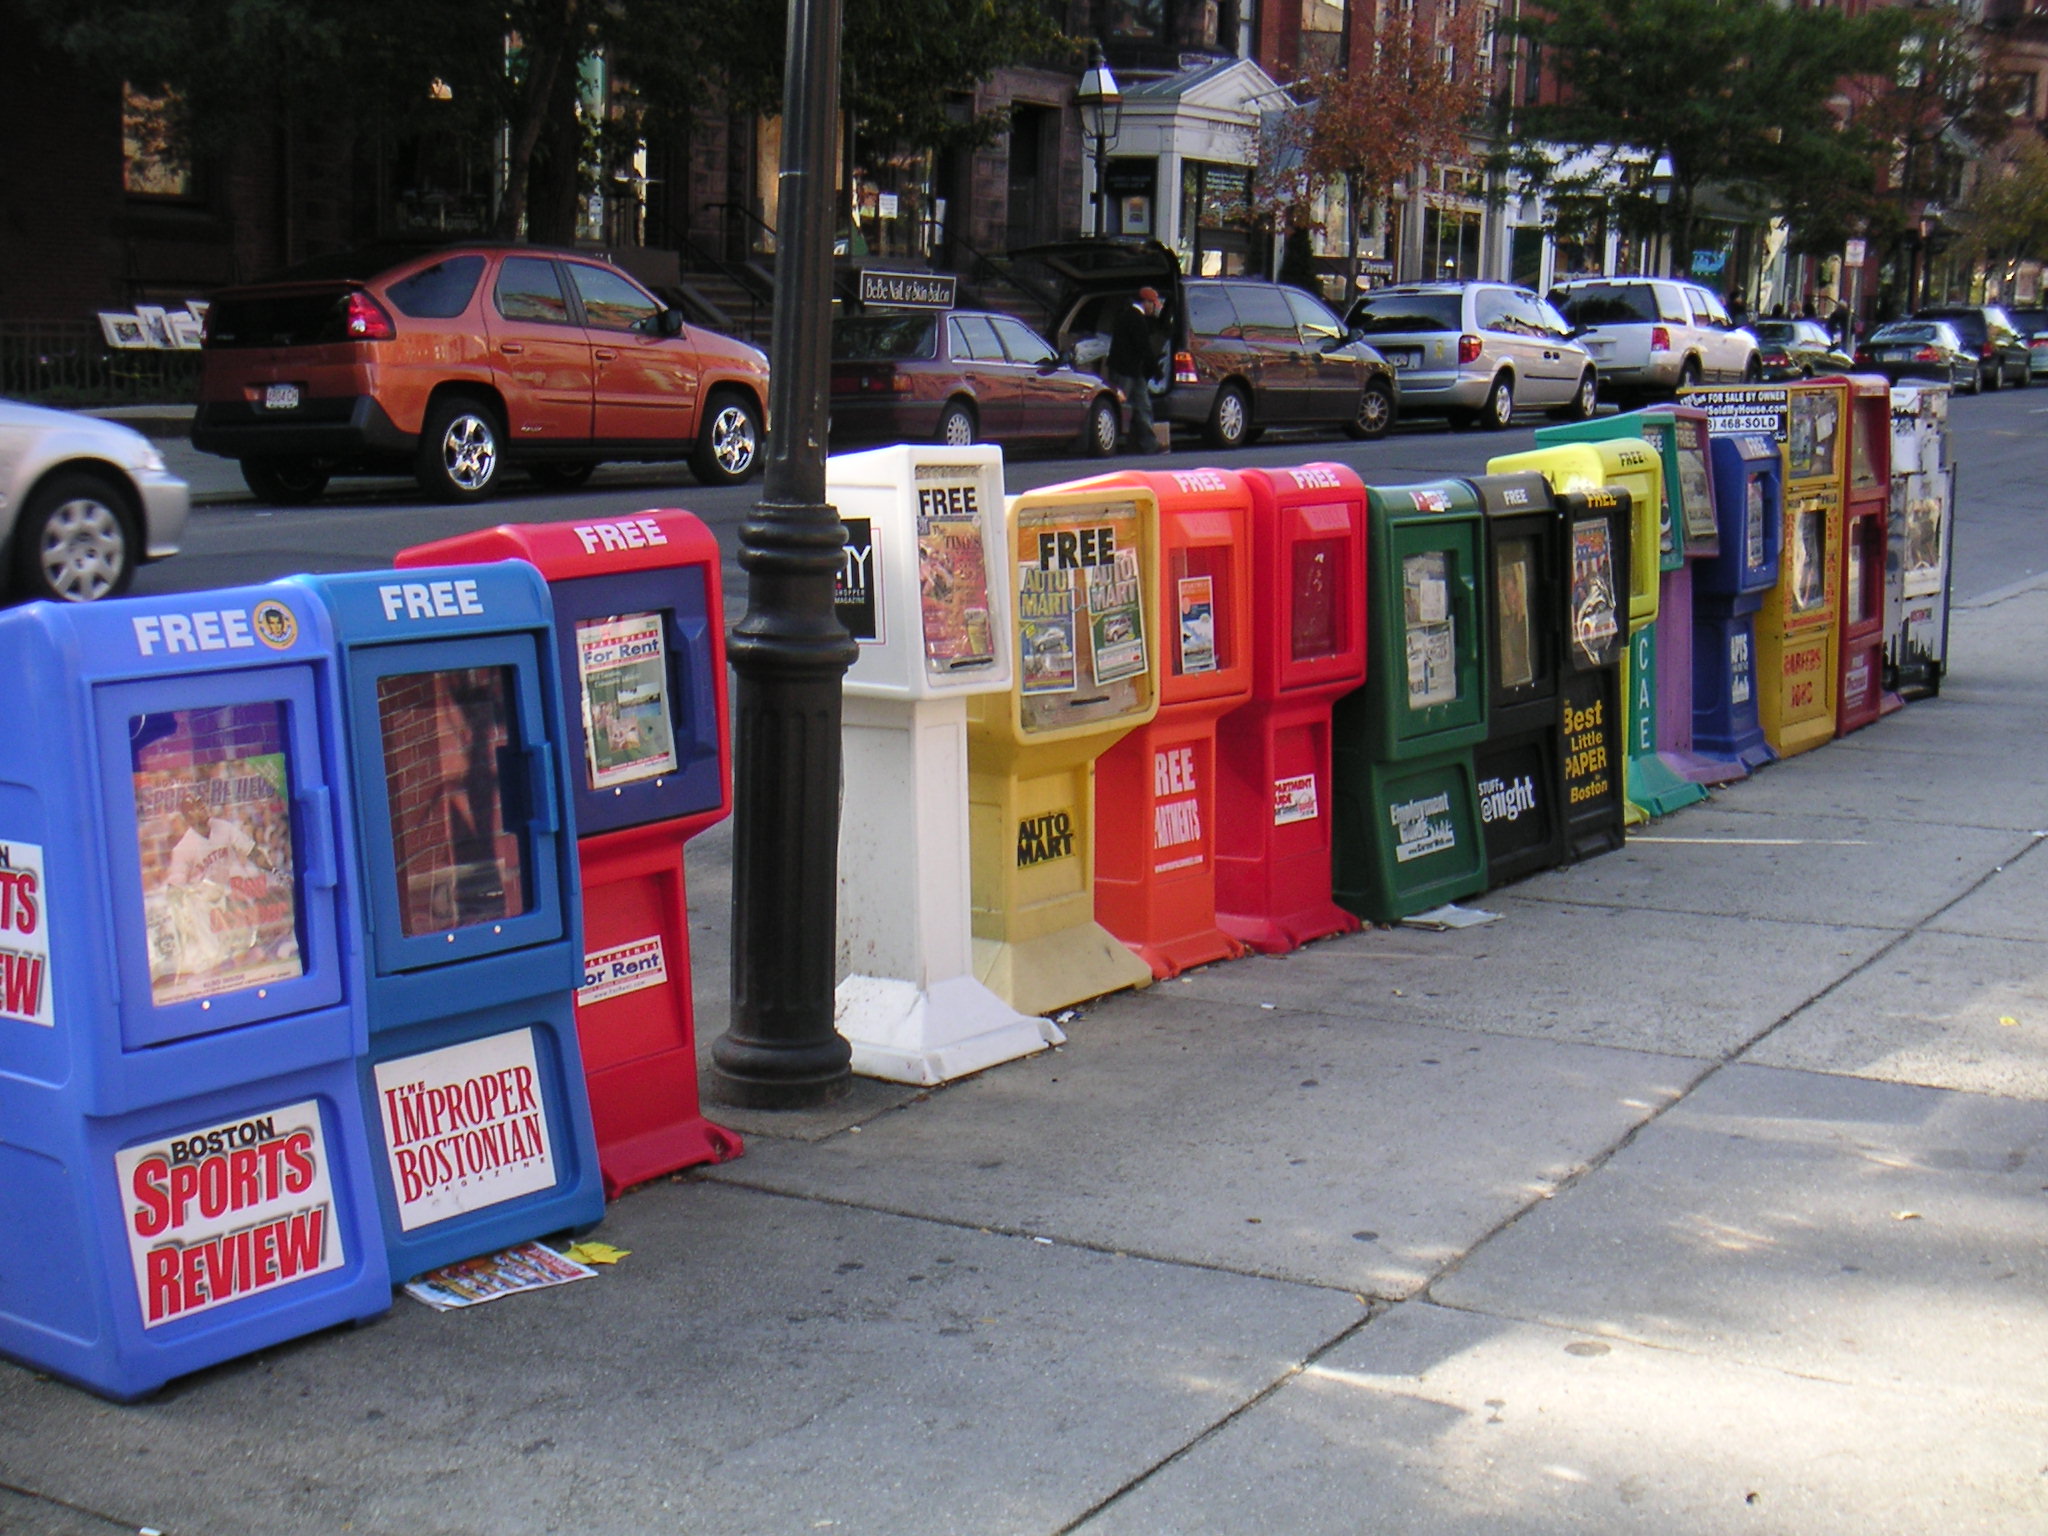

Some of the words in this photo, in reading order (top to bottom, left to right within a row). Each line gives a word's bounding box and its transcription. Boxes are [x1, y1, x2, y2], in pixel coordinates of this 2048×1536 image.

[1708, 393, 1724, 403] FOR
[1725, 392, 1744, 403] SALE
[1746, 391, 1757, 402] BY
[1758, 390, 1786, 402] OWNER
[1720, 417, 1776, 429] 468-SOLD
[1619, 452, 1644, 467] FREE
[1744, 436, 1770, 456] FREE
[1173, 472, 1226, 493] FREE
[1289, 468, 1340, 490] FREE
[919, 487, 978, 516] FREE
[1504, 489, 1528, 505] FREE
[1587, 492, 1618, 508] FREE
[574, 519, 667, 554] FREE
[1039, 527, 1115, 572] FREE
[379, 579, 484, 621] FREE
[1021, 592, 1071, 618] MART
[133, 609, 254, 656] FREE
[584, 650, 613, 666] For
[619, 638, 659, 657] Rent
[1563, 700, 1602, 734] Best
[1571, 731, 1603, 752] Little
[1565, 746, 1607, 780] PAPER
[1480, 775, 1535, 822] @night
[1570, 780, 1608, 804] Boston
[1018, 812, 1070, 845] AUTO
[1016, 834, 1074, 868] MART
[612, 953, 660, 978] Rent
[397, 1080, 426, 1097] THE
[385, 1065, 537, 1148] IMPROPER
[170, 1116, 276, 1165] BOSTON
[394, 1113, 545, 1205] BOSTONIAN
[132, 1128, 317, 1238] SPORTS
[425, 1157, 546, 1198] MAGAZINE
[146, 1205, 327, 1323] REVIEW
